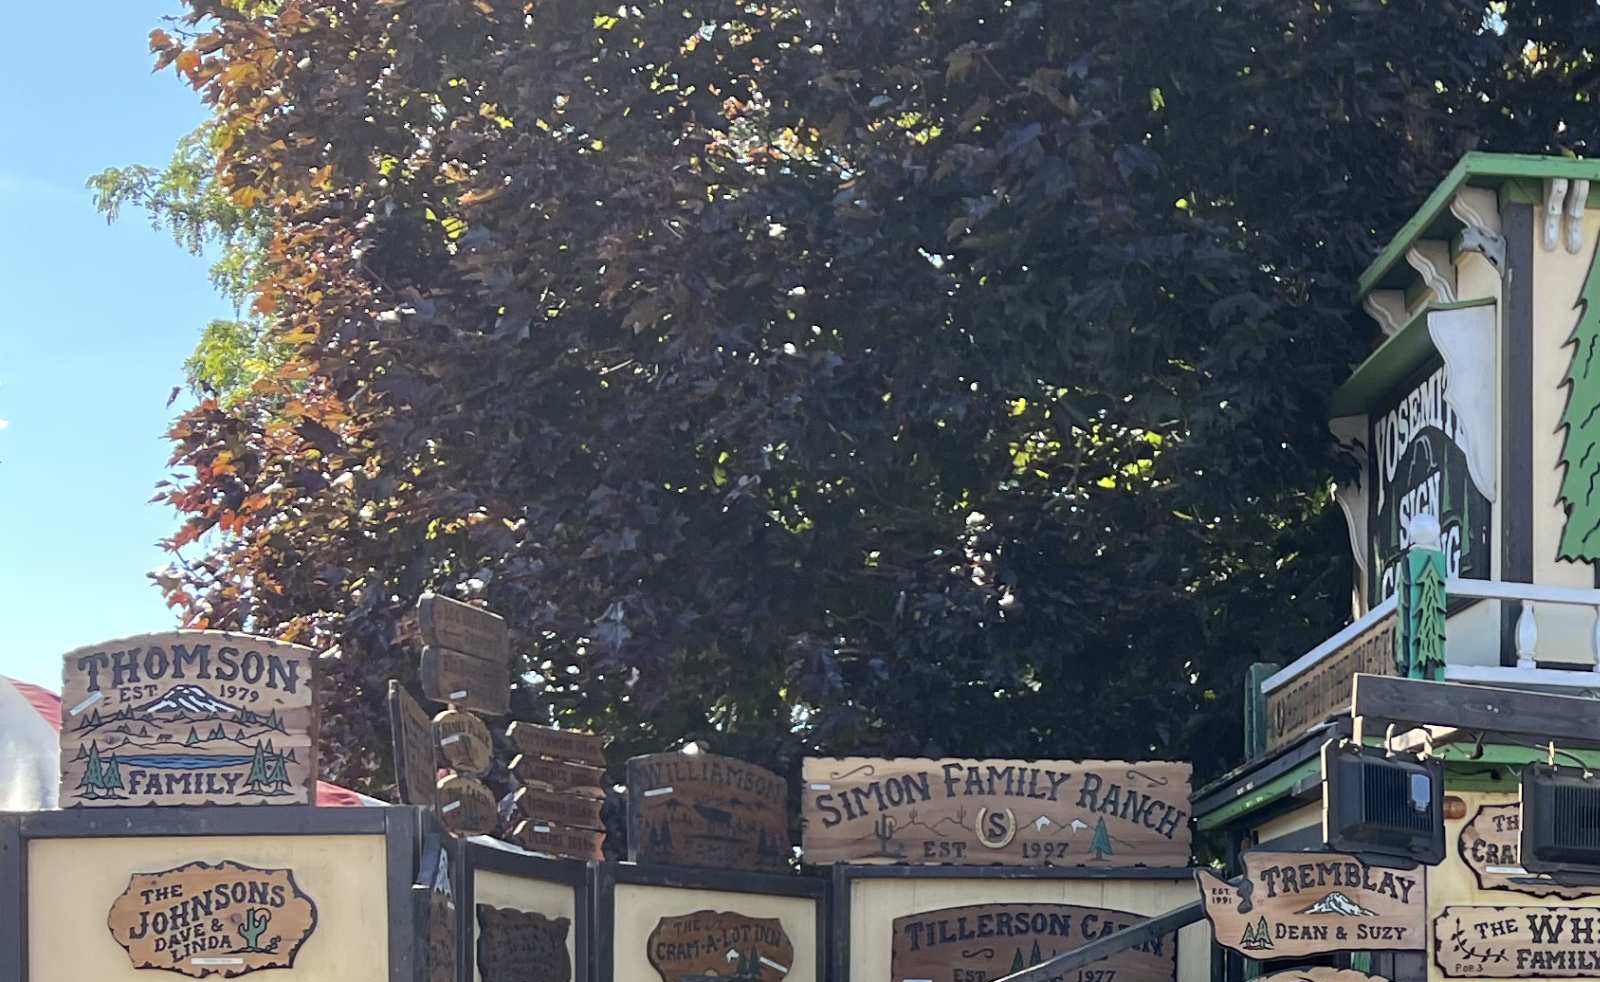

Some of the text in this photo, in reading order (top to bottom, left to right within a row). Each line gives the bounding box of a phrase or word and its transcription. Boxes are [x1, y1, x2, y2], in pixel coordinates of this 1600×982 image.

[78, 643, 300, 693] THOMSON
[220, 684, 259, 702] 1979
[128, 768, 244, 796] FAMILY
[642, 761, 784, 796] WILLIAMSON
[815, 763, 1187, 840] SIMON FAMILY RANCH
[1022, 842, 1069, 858] 1997
[1261, 862, 1415, 904] TREMBLAY
[129, 880, 286, 941] THE JOHNSONS
[154, 923, 205, 953] DAVE
[674, 920, 702, 933] THE
[904, 912, 1071, 951] TILLERSON
[1275, 923, 1406, 940] DEAN SUZY
[1475, 919, 1518, 939] THE
[170, 933, 233, 962] LINDA
